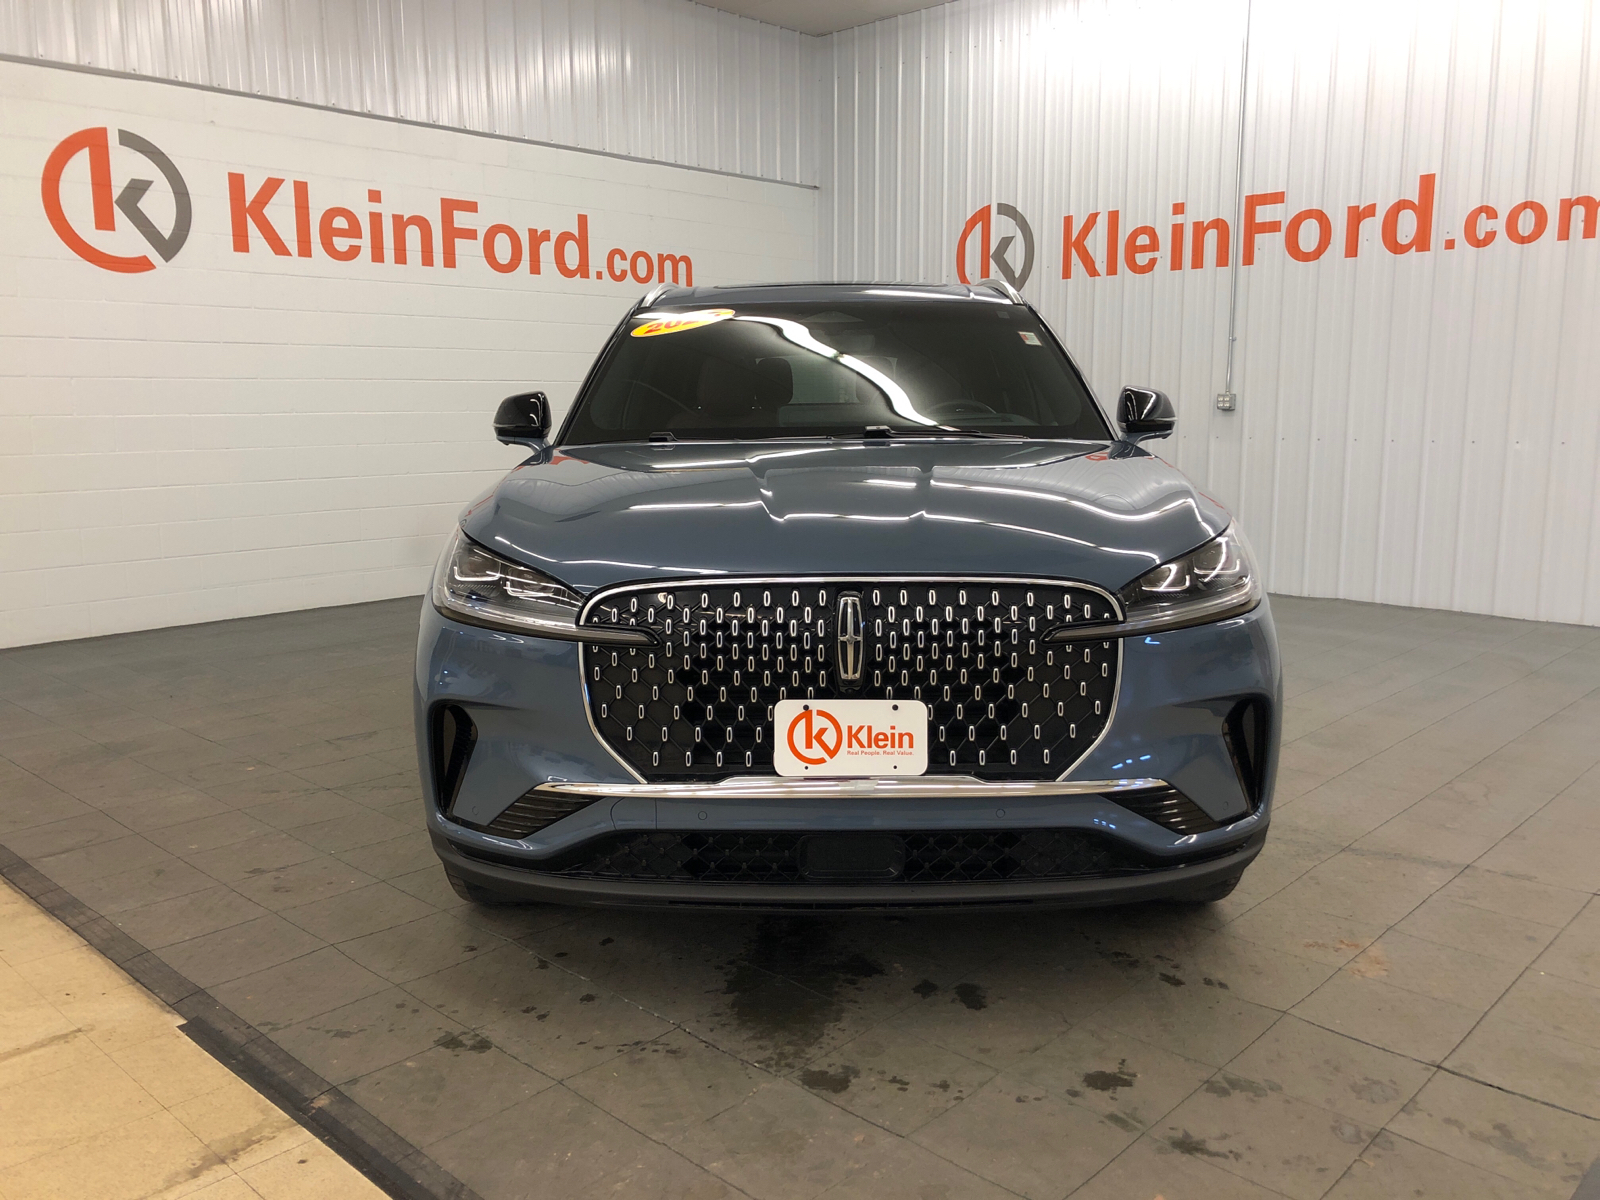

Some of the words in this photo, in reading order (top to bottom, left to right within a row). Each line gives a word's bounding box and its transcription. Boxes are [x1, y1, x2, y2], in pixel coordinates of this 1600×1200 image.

[228, 171, 693, 288] KleinFord.com
[1061, 173, 1600, 280] KleinFord.com
[847, 725, 914, 749] Klein
